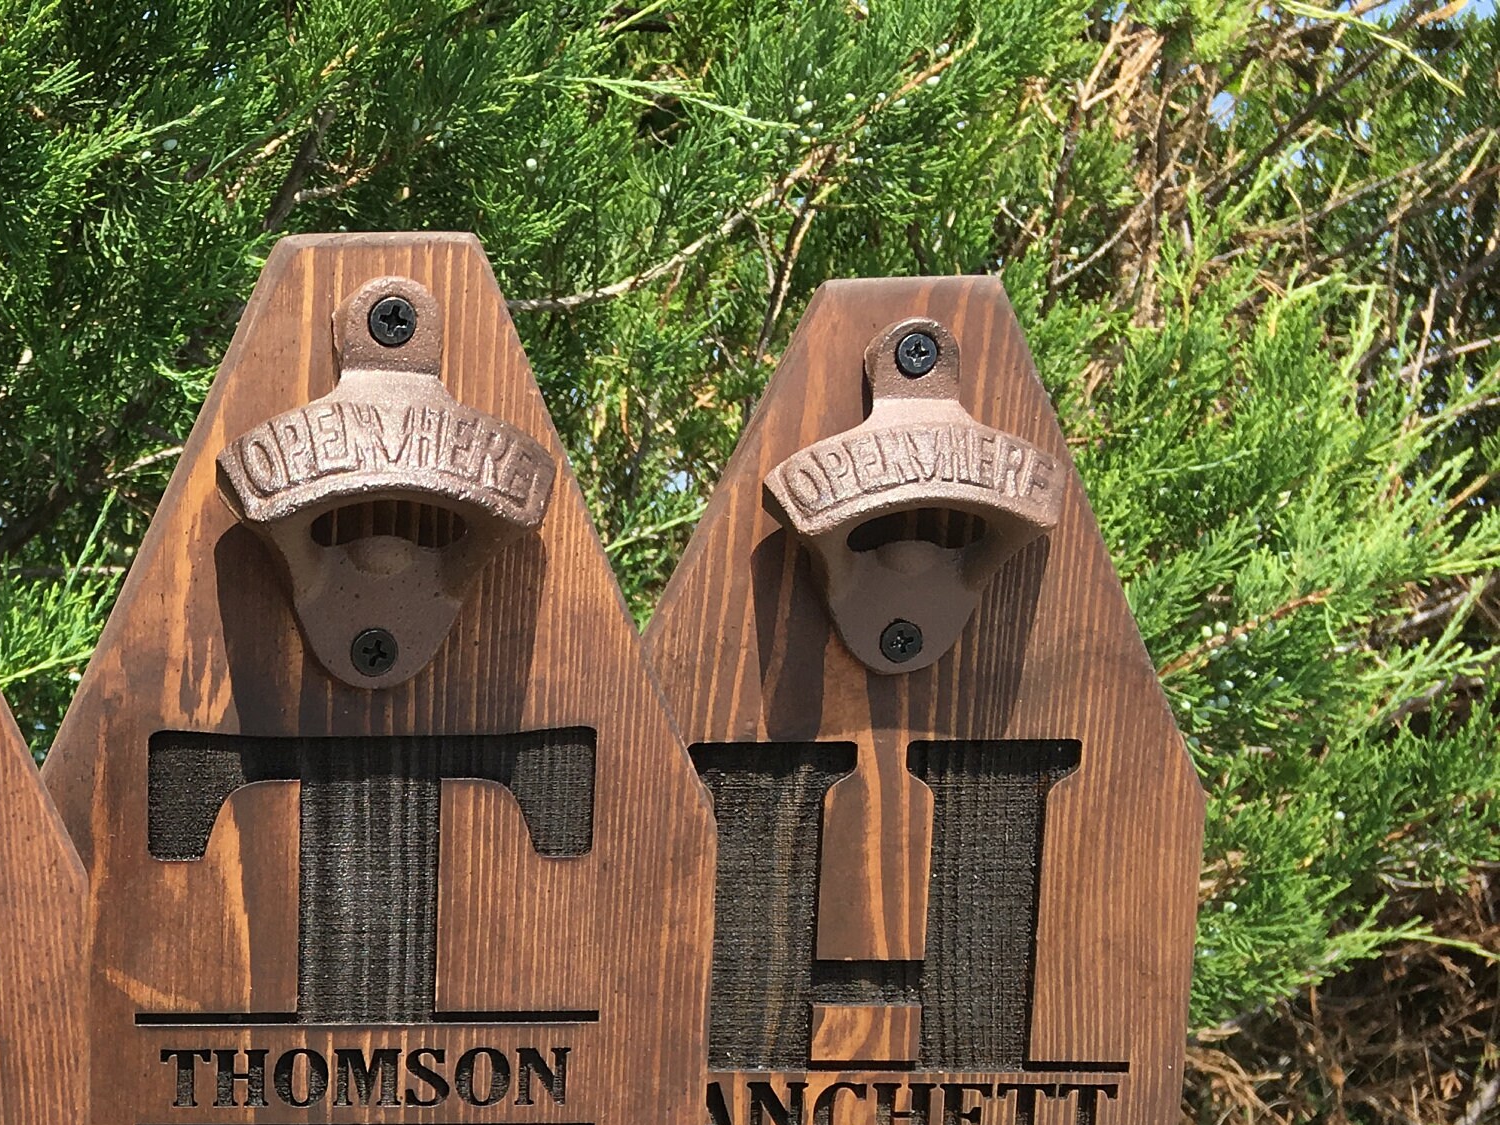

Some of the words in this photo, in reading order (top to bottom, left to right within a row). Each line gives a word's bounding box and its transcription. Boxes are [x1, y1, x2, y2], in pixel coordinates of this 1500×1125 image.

[239, 402, 390, 499] OPEN
[399, 407, 536, 508] HERE
[781, 429, 924, 517] OPEN
[930, 425, 1053, 502] HERE
[160, 1046, 572, 1108] THOMSON
